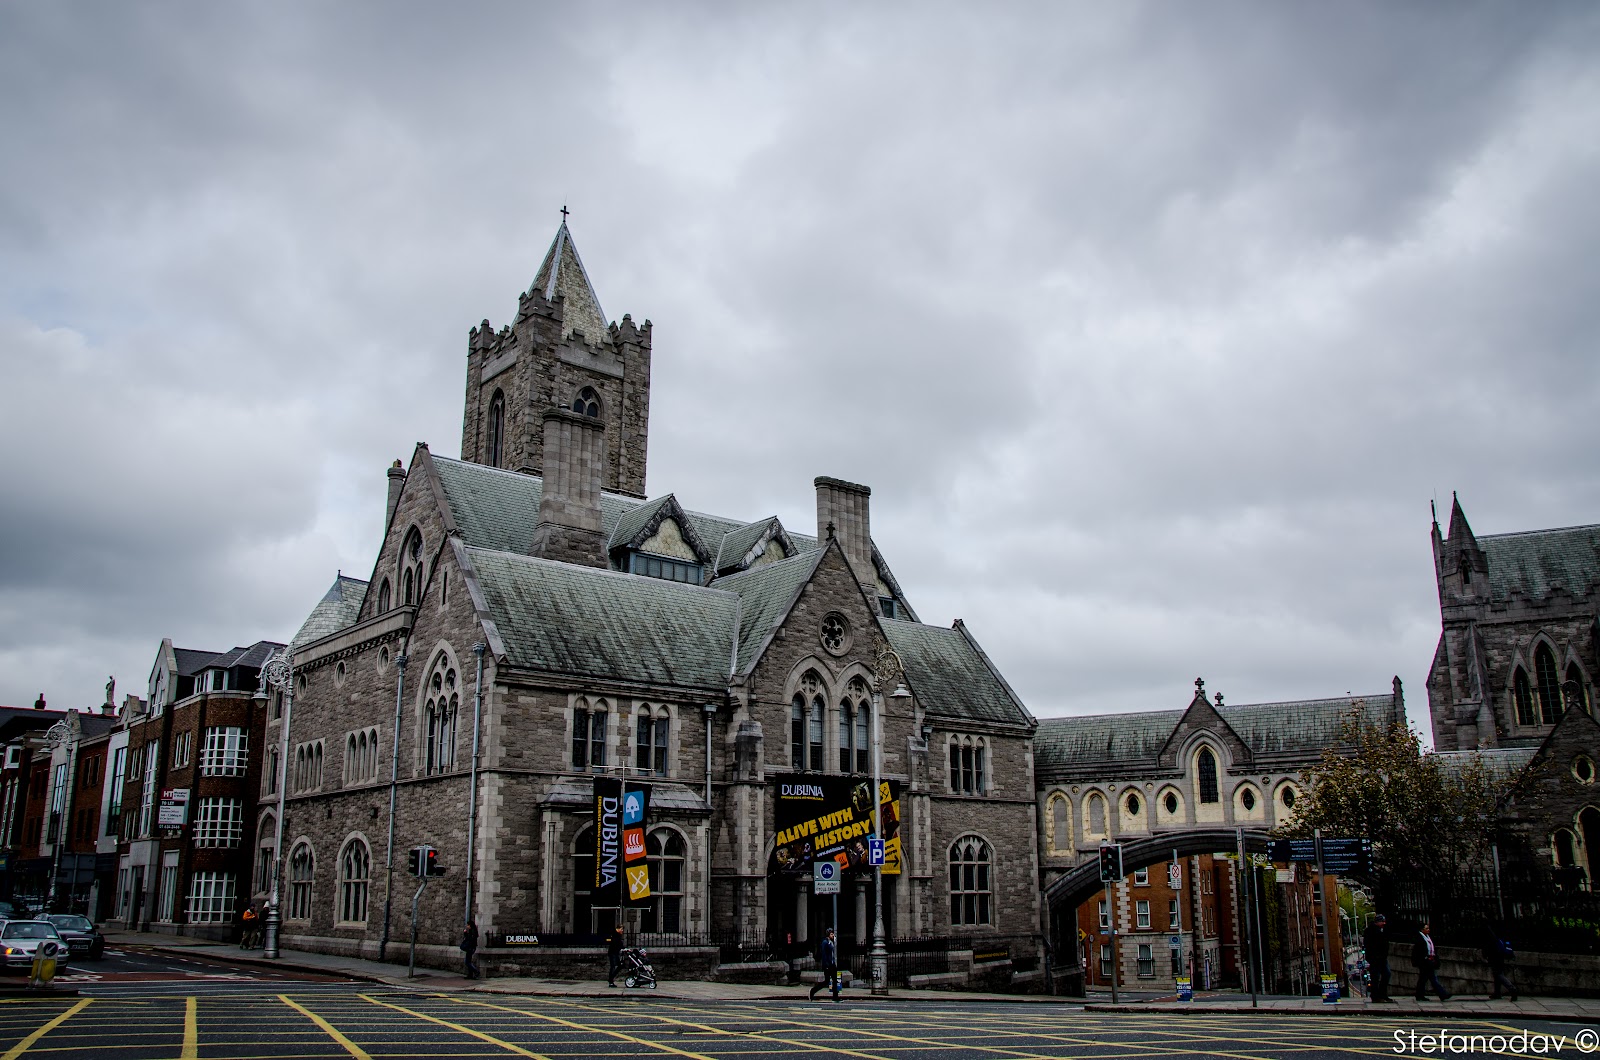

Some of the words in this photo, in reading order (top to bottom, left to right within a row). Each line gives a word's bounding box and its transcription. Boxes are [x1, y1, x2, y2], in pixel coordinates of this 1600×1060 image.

[781, 784, 824, 797] DUBLINIA
[777, 819, 818, 846] ALIVE
[818, 807, 853, 830] WITH
[815, 819, 870, 850] HISTORY
[601, 797, 618, 888] DUBLINIA
[872, 848, 883, 864] P
[505, 935, 539, 943] DUBLINIA
